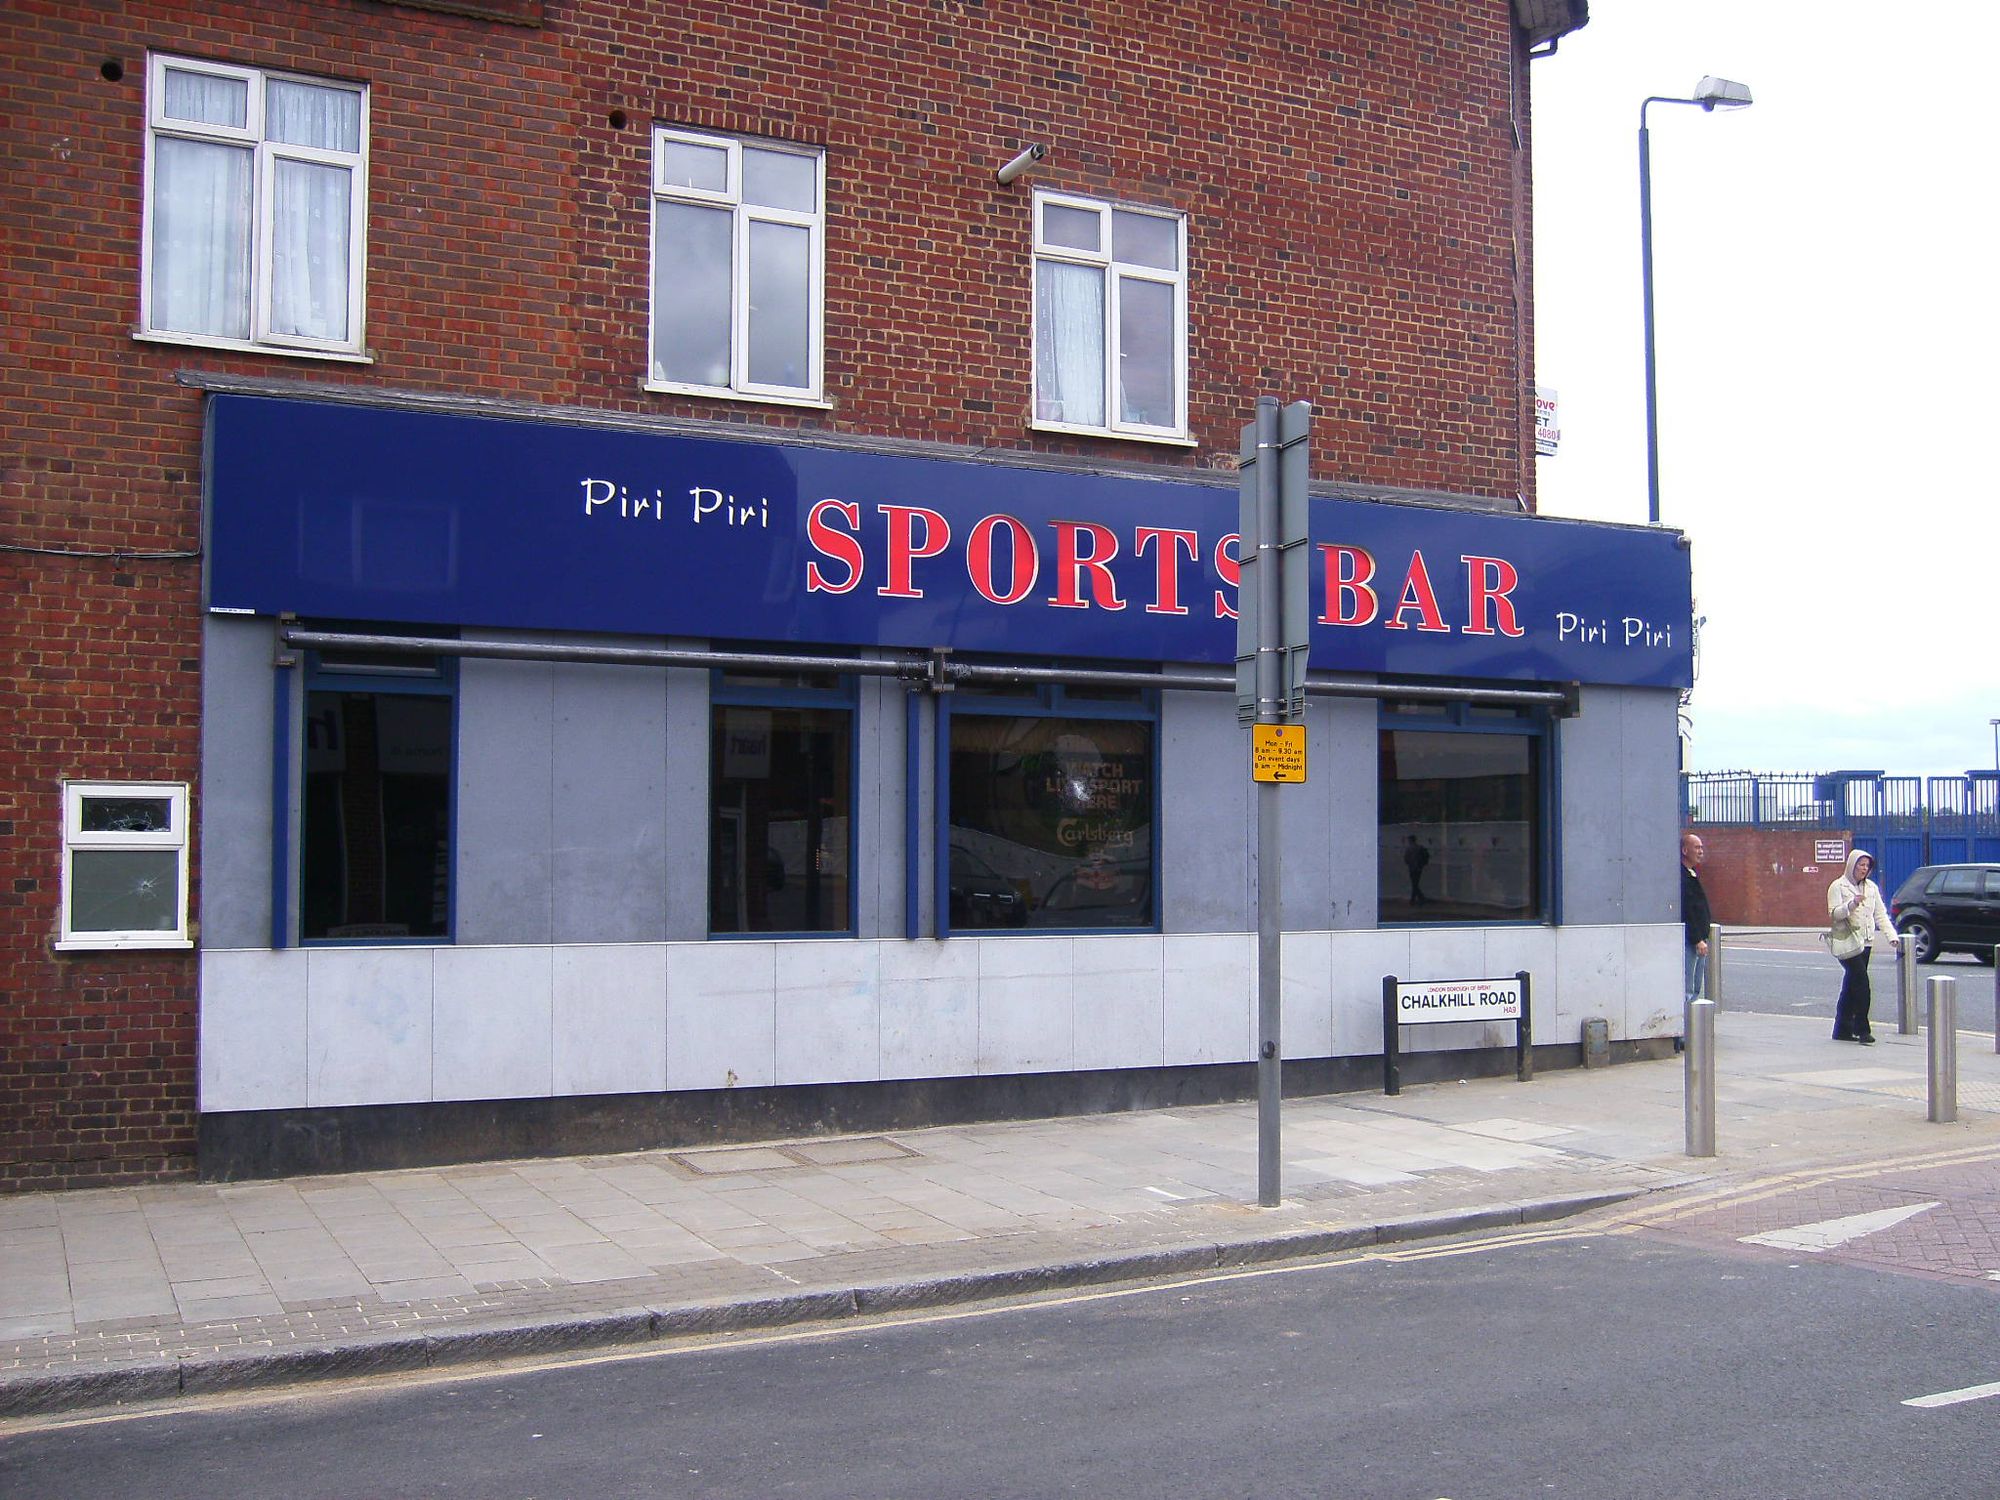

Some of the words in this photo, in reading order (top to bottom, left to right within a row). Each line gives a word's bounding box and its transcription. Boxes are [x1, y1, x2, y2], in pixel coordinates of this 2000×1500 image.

[580, 477, 663, 520] Piri
[689, 486, 768, 527] Piri
[1315, 543, 1525, 638] BAR
[1556, 612, 1606, 644] Piri
[1622, 616, 1671, 648] Piri
[1056, 818, 1134, 847] Carlsberg
[1401, 993, 1475, 1010] CHALKHILL
[1480, 991, 1517, 1006] ROAD
[1503, 1006, 1517, 1014] HA9
